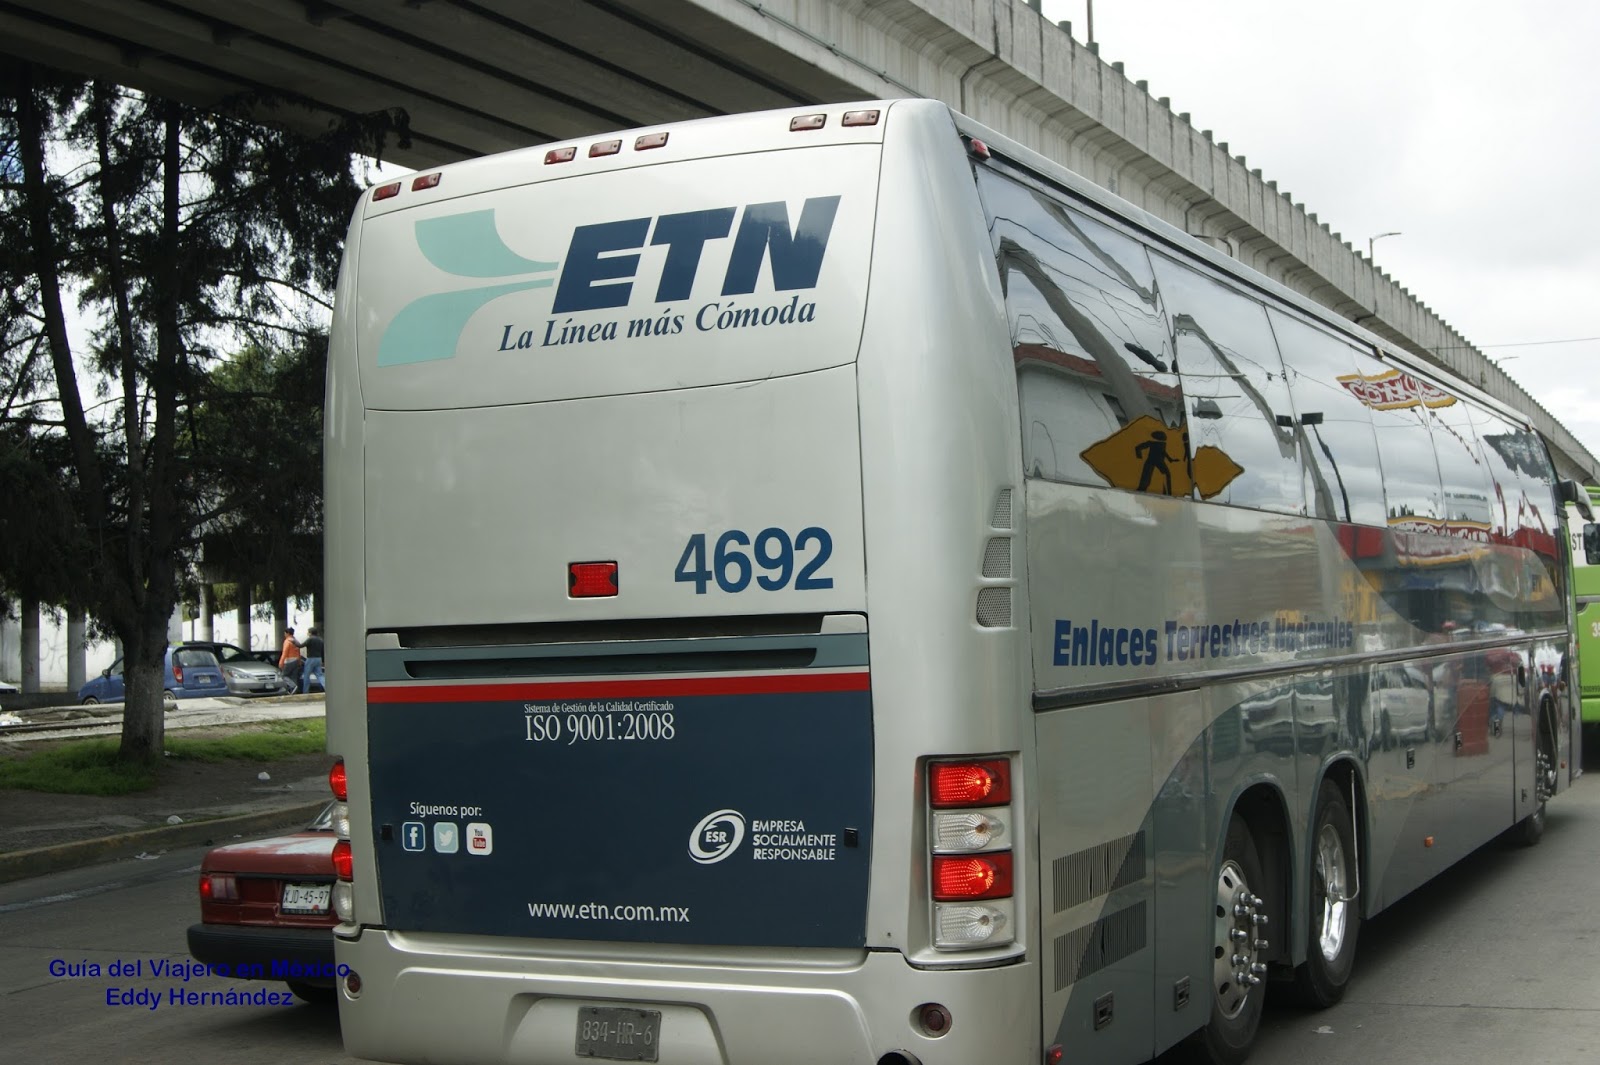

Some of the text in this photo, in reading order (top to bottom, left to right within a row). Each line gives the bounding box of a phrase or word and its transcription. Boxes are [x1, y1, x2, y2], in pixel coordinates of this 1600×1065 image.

[551, 195, 842, 315] ETN
[497, 295, 817, 352] La Línea más Cómoda
[674, 526, 834, 595] 4692
[1053, 619, 1158, 667] Enlaces
[1164, 618, 1271, 662] Terrestres
[524, 700, 674, 714] Sistema de Gestión de la Calidad Certificado
[525, 712, 675, 745] ISO 9001:2008
[410, 802, 482, 819] Síguenos por:
[752, 820, 805, 832] EMPRESA
[705, 831, 727, 843] ESR
[753, 834, 837, 847] SOCIALMENTE
[753, 848, 836, 860] RESPONSABLE
[528, 902, 690, 922] www.etn.com.mx
[582, 1020, 652, 1046] 834-HR-6
